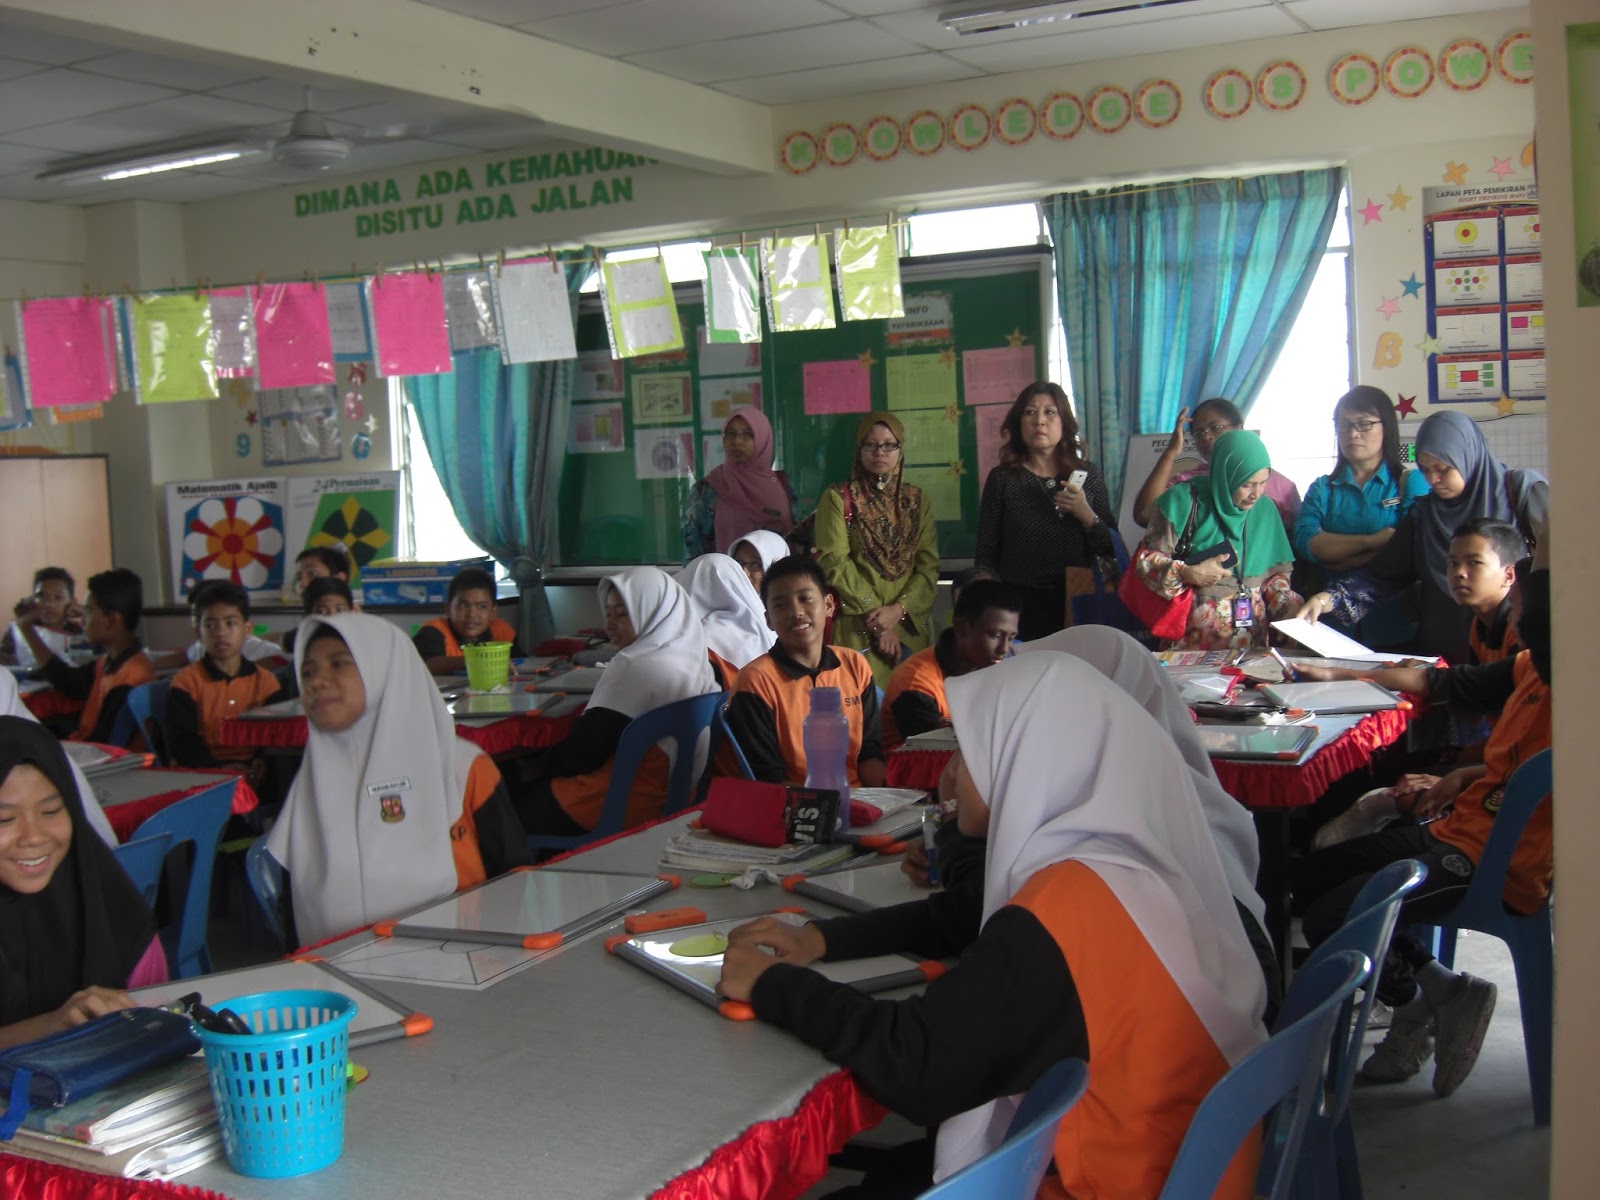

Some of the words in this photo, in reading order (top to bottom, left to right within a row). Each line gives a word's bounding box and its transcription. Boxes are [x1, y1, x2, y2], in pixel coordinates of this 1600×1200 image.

[790, 93, 1169, 164] KNOWLEDGE
[1225, 74, 1294, 107] IS
[295, 178, 400, 217] DIMANA
[416, 167, 474, 198] ADA
[356, 205, 443, 238] DISITU
[456, 193, 517, 225] ADA
[531, 176, 634, 213] JALAN
[1436, 189, 1461, 199] LAPAN
[1463, 187, 1481, 196] PETA
[1483, 185, 1526, 194] PEMIKIRAN
[906, 305, 929, 315] INFO
[177, 482, 242, 495] Matematik
[246, 480, 278, 491] Ajaib
